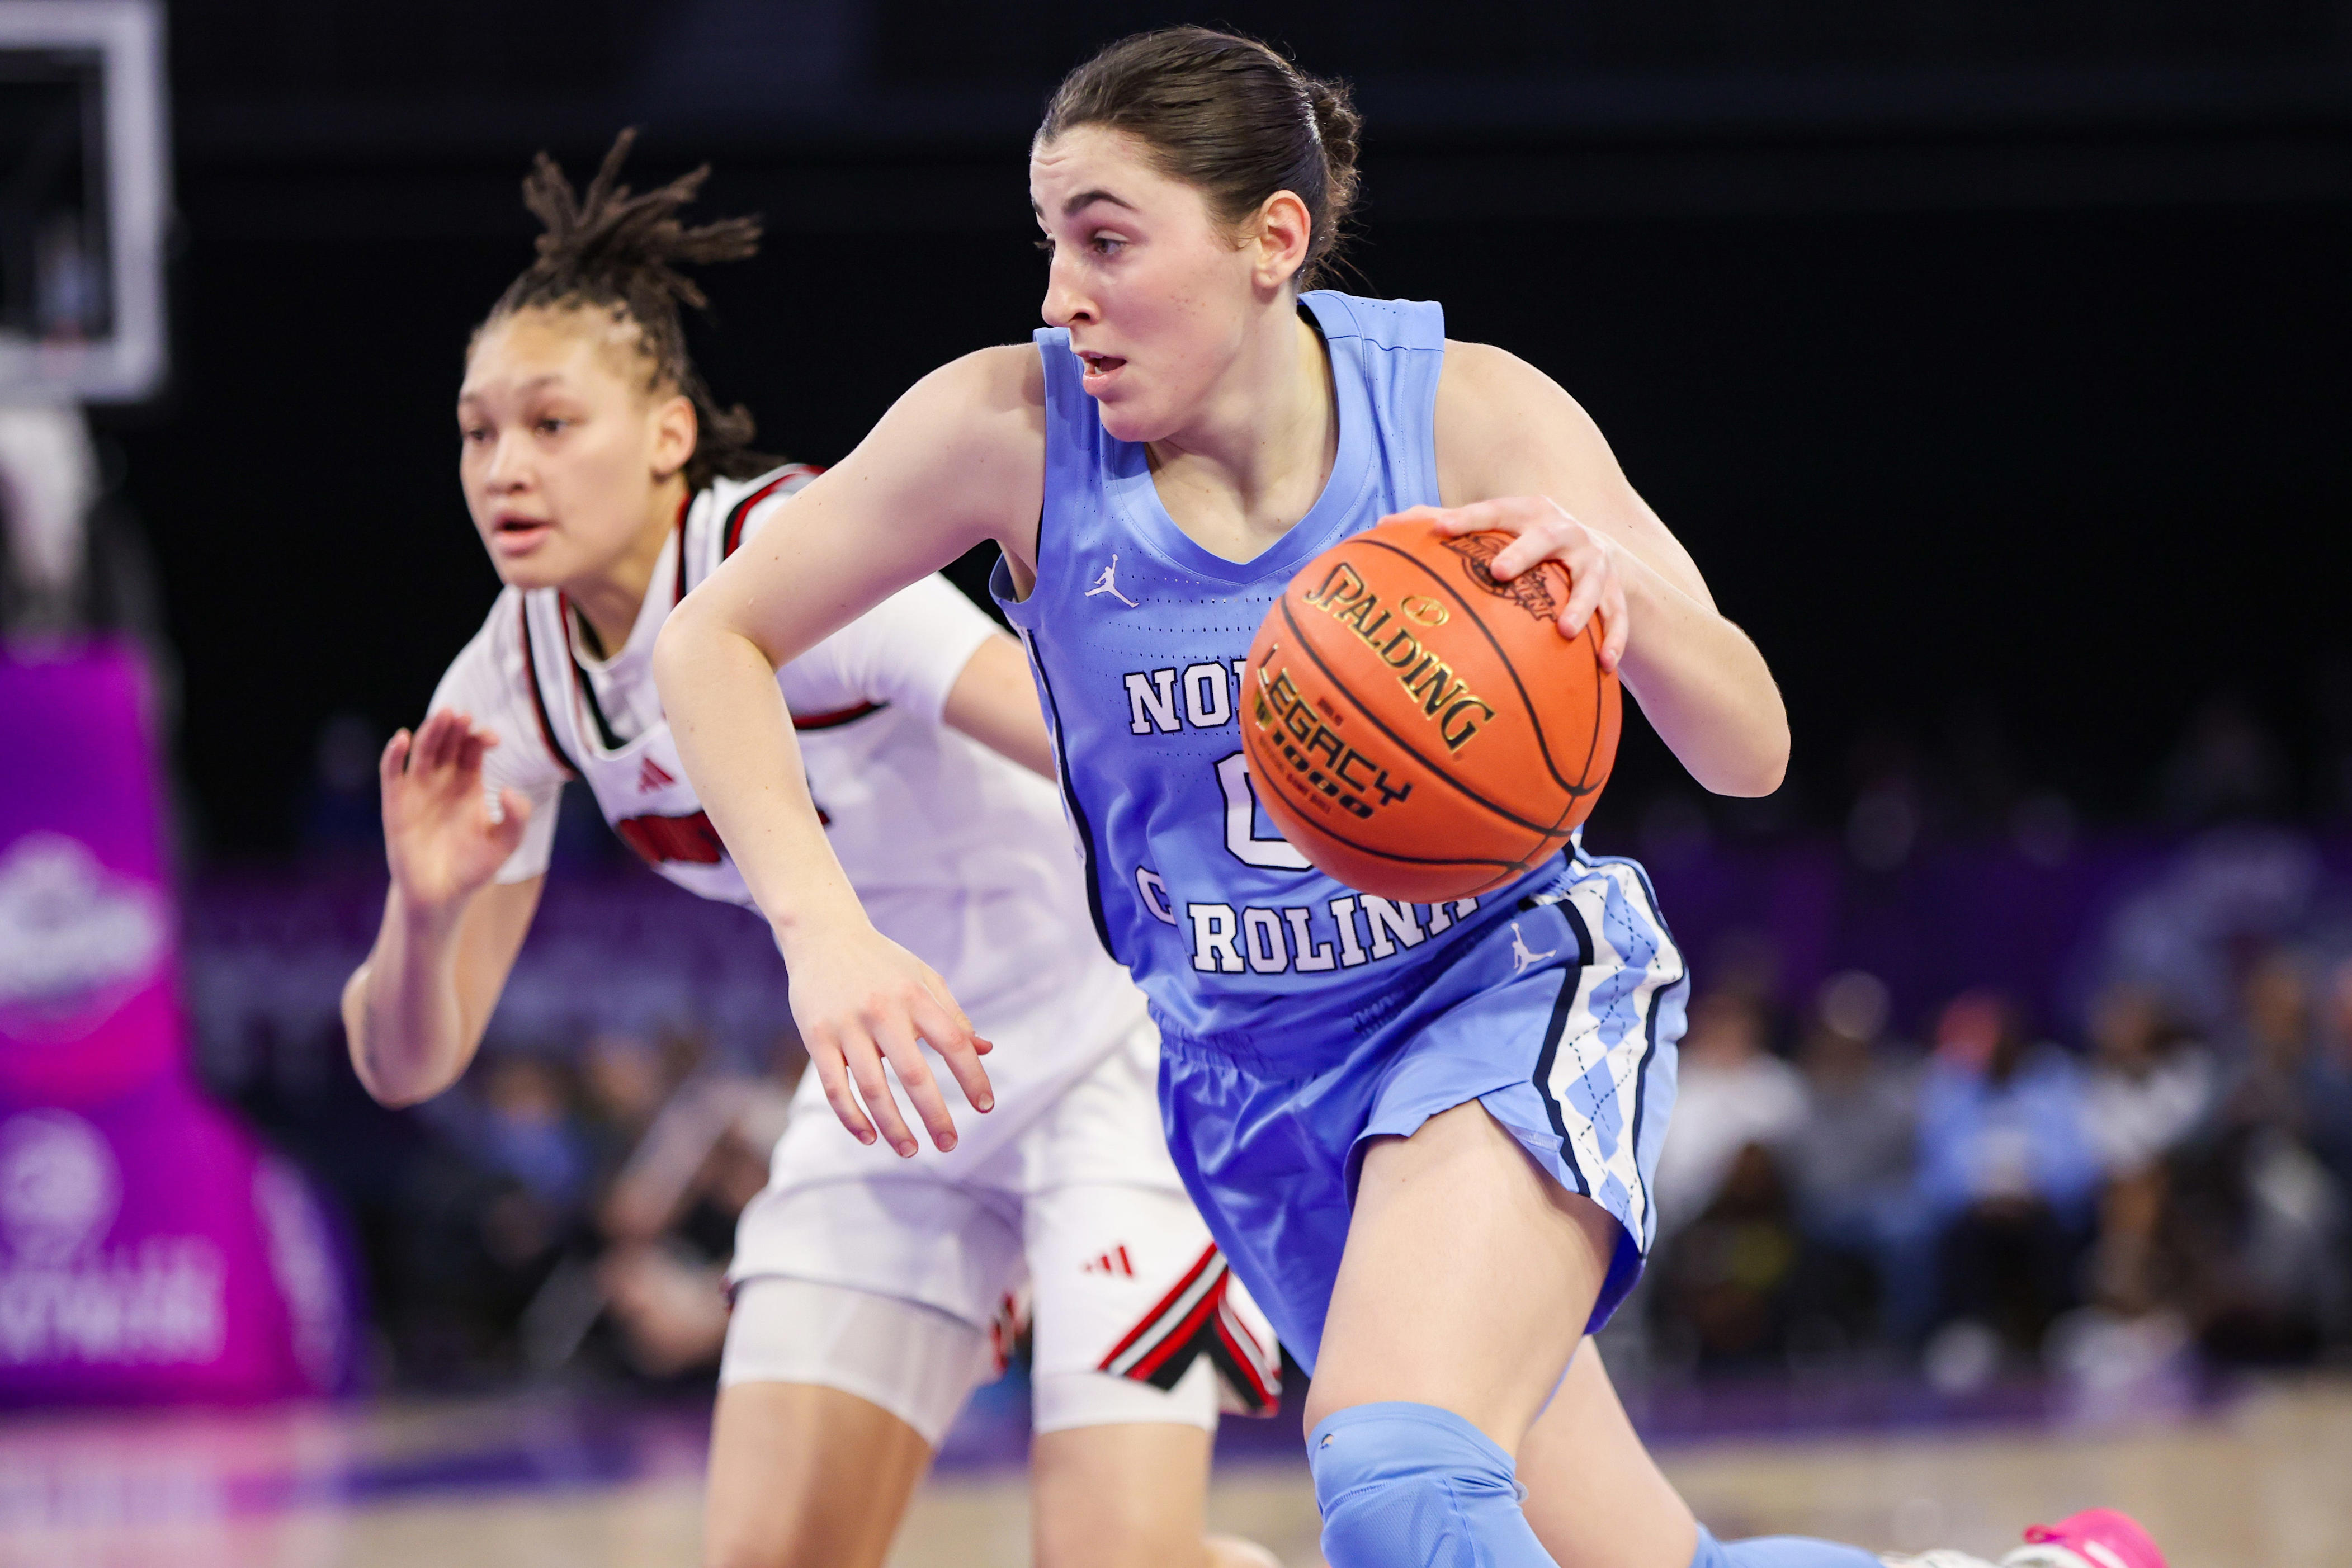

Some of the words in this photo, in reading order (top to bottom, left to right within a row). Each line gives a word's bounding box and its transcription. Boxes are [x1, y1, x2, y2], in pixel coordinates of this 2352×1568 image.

[1123, 658, 1247, 735] NO
[1257, 642, 1413, 807] LEGACY
[1302, 561, 1496, 754] SPALDING
[1135, 865, 1480, 974] CROLIN
